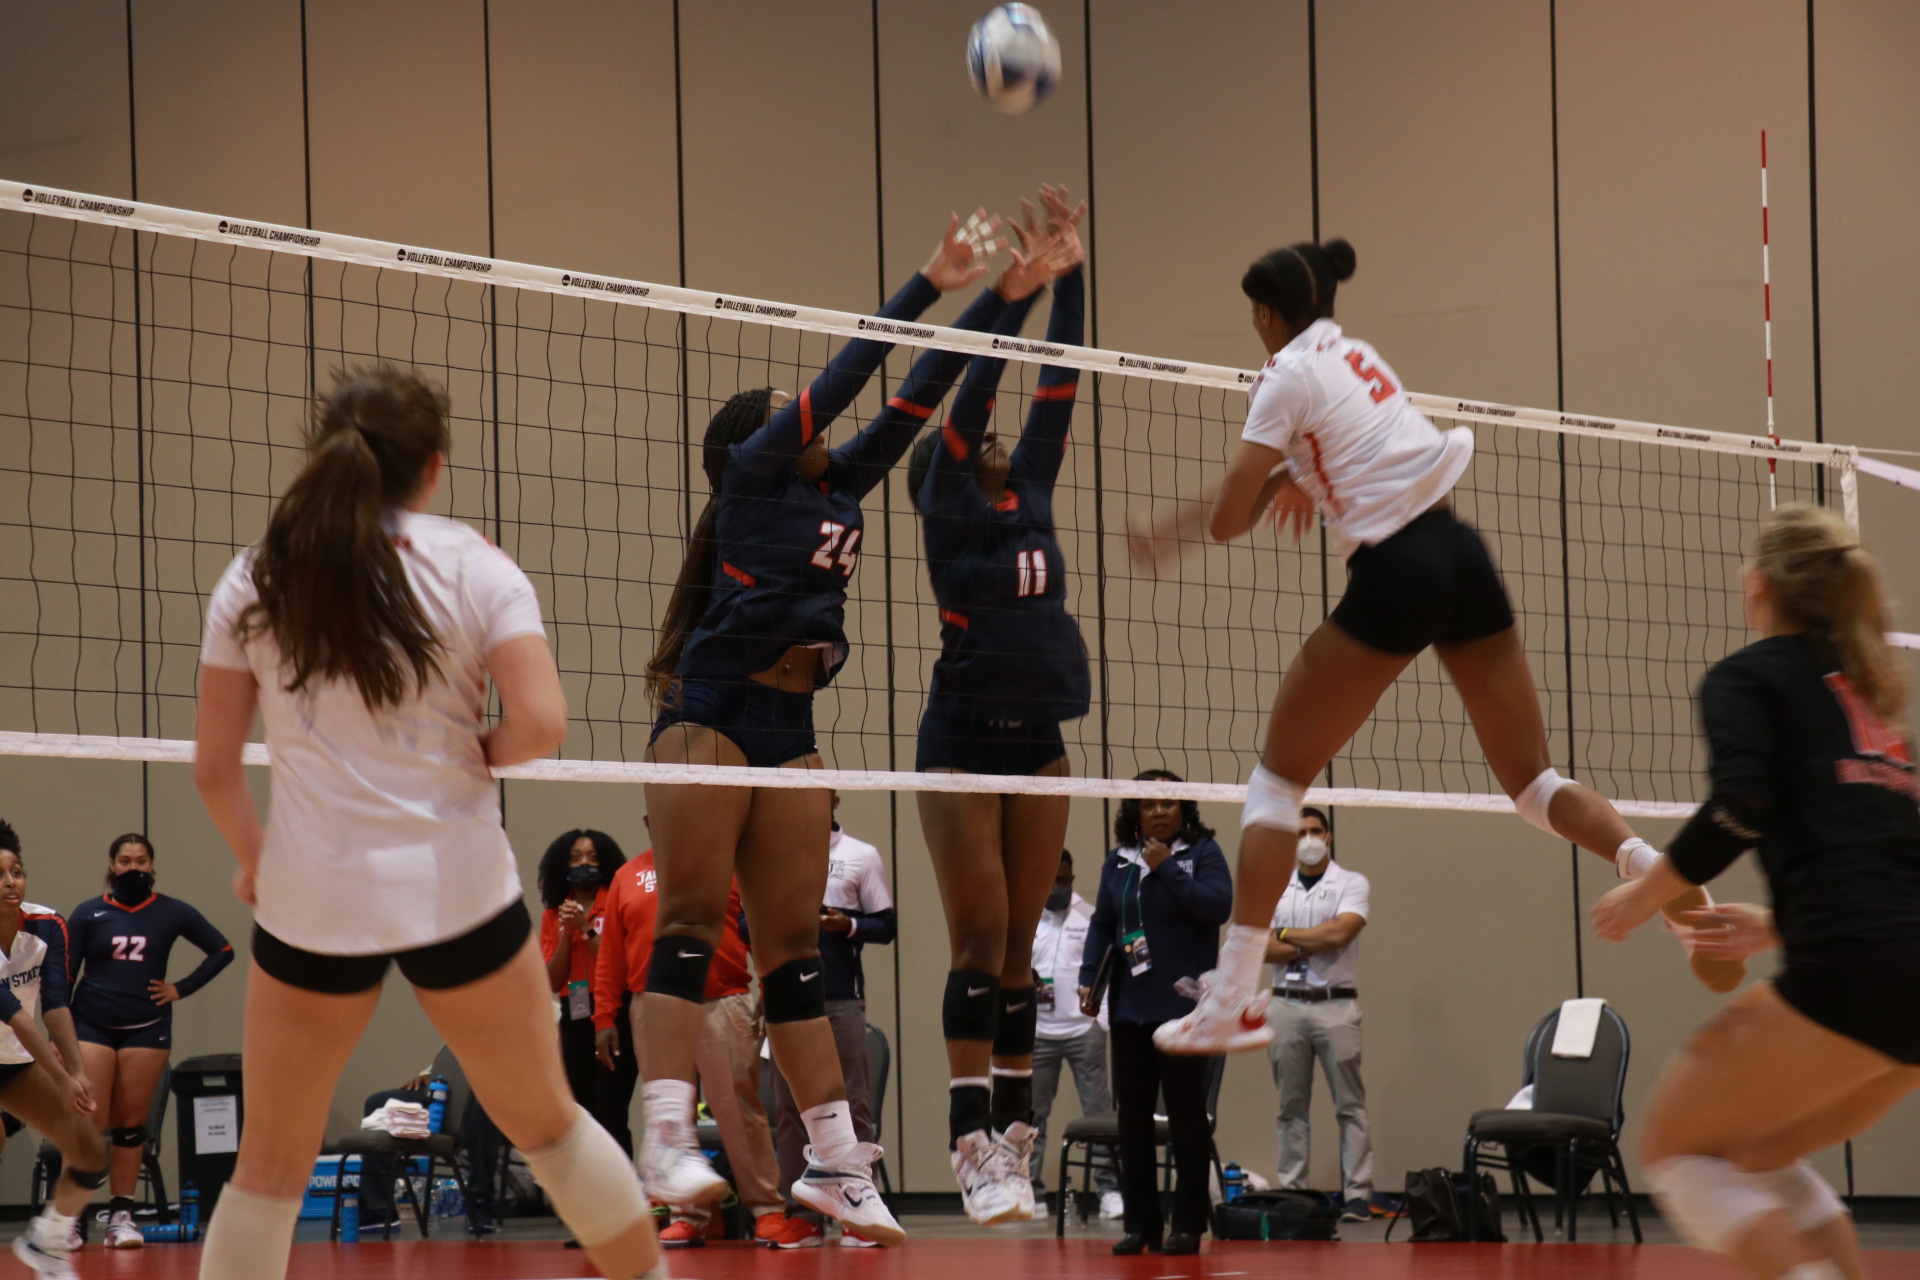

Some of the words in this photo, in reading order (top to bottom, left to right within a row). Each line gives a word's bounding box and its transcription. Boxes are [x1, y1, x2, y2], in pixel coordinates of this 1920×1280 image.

[34, 192, 77, 209] VOLLEYBALL
[79, 199, 135, 217] CHAMPIONSHIP
[228, 224, 269, 239] VOLLEYBALL
[269, 230, 321, 246] CHAMPIONSHIP
[407, 252, 443, 266] VOLLEYBALL
[444, 257, 492, 273] CHAMPIONSHIP
[570, 277, 605, 291] VOLLEYBALL
[605, 282, 650, 297] CHAMPIONSHIP
[723, 300, 755, 313] VOLLEYBALL
[755, 304, 797, 318] CHAMPIONSHIP
[865, 321, 896, 333] VOLLEYBALL
[896, 325, 935, 338] CHAMPIONSHIP
[999, 340, 1027, 352] VOLLEYBALL
[1028, 344, 1065, 356] CHAMPIONSHIP
[1125, 359, 1152, 370] VOLLEYBALL
[1344, 349, 1396, 404] 5
[809, 519, 862, 577] 24
[1017, 548, 1048, 598] 11
[111, 935, 147, 962] 22
